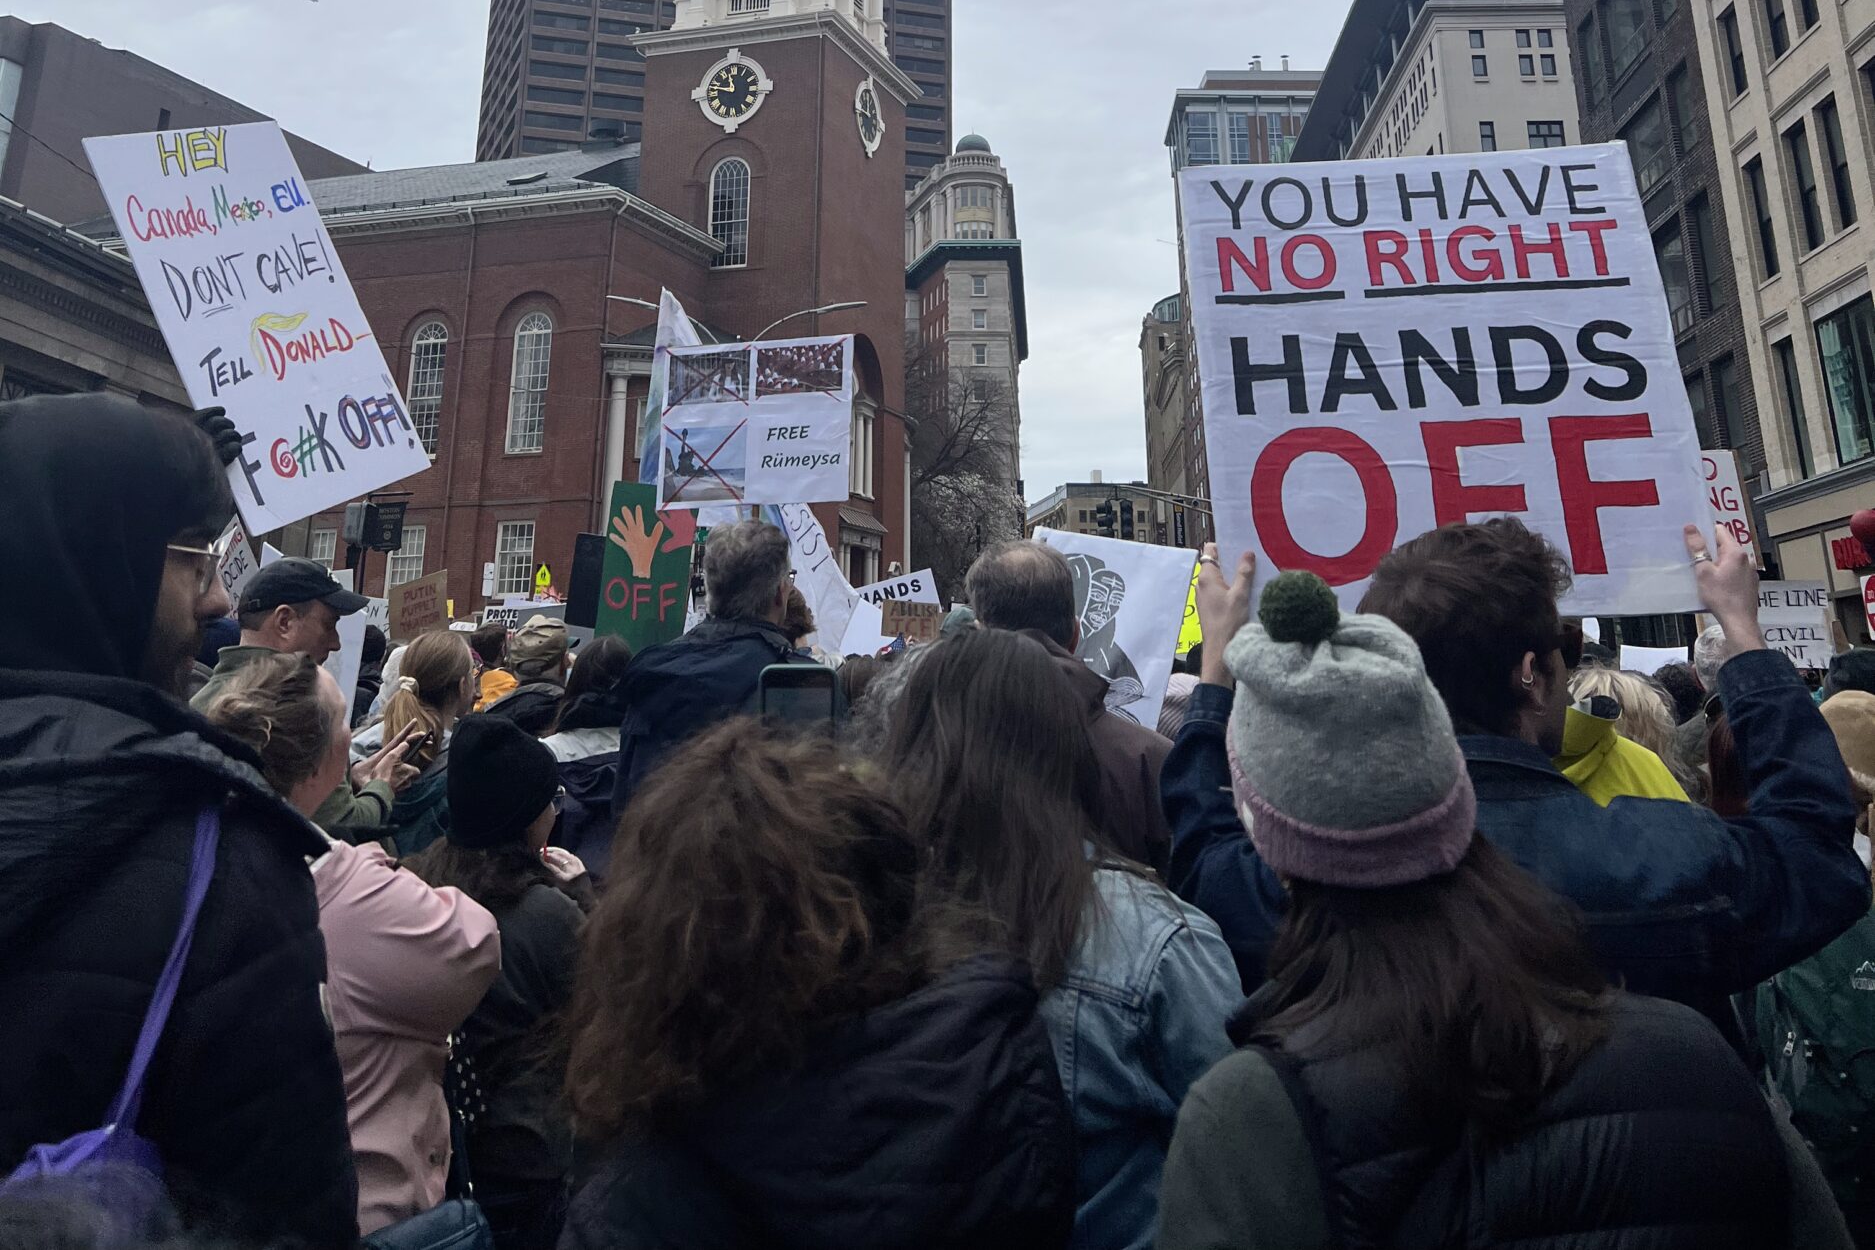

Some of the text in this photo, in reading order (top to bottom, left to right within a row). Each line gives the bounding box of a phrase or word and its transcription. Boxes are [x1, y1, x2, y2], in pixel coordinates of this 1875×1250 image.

[157, 127, 229, 177] HEY
[127, 194, 217, 242] Canada,
[1210, 164, 1606, 230] YOU HAVE
[257, 229, 335, 293] CAVE!
[1216, 219, 1617, 292] NO RIGHT
[200, 347, 253, 396] TELL
[1230, 320, 1648, 416] HANDS
[767, 425, 810, 441] FREE
[761, 452, 841, 471] Rümeysa
[1251, 413, 1660, 587] OFF
[403, 583, 436, 600] PUTIN
[486, 609, 518, 619] PROTE
[604, 577, 678, 622] OFF
[1757, 589, 1826, 607] HE LINE
[1764, 627, 1825, 642] CIVIL
[1779, 645, 1809, 660] NT
